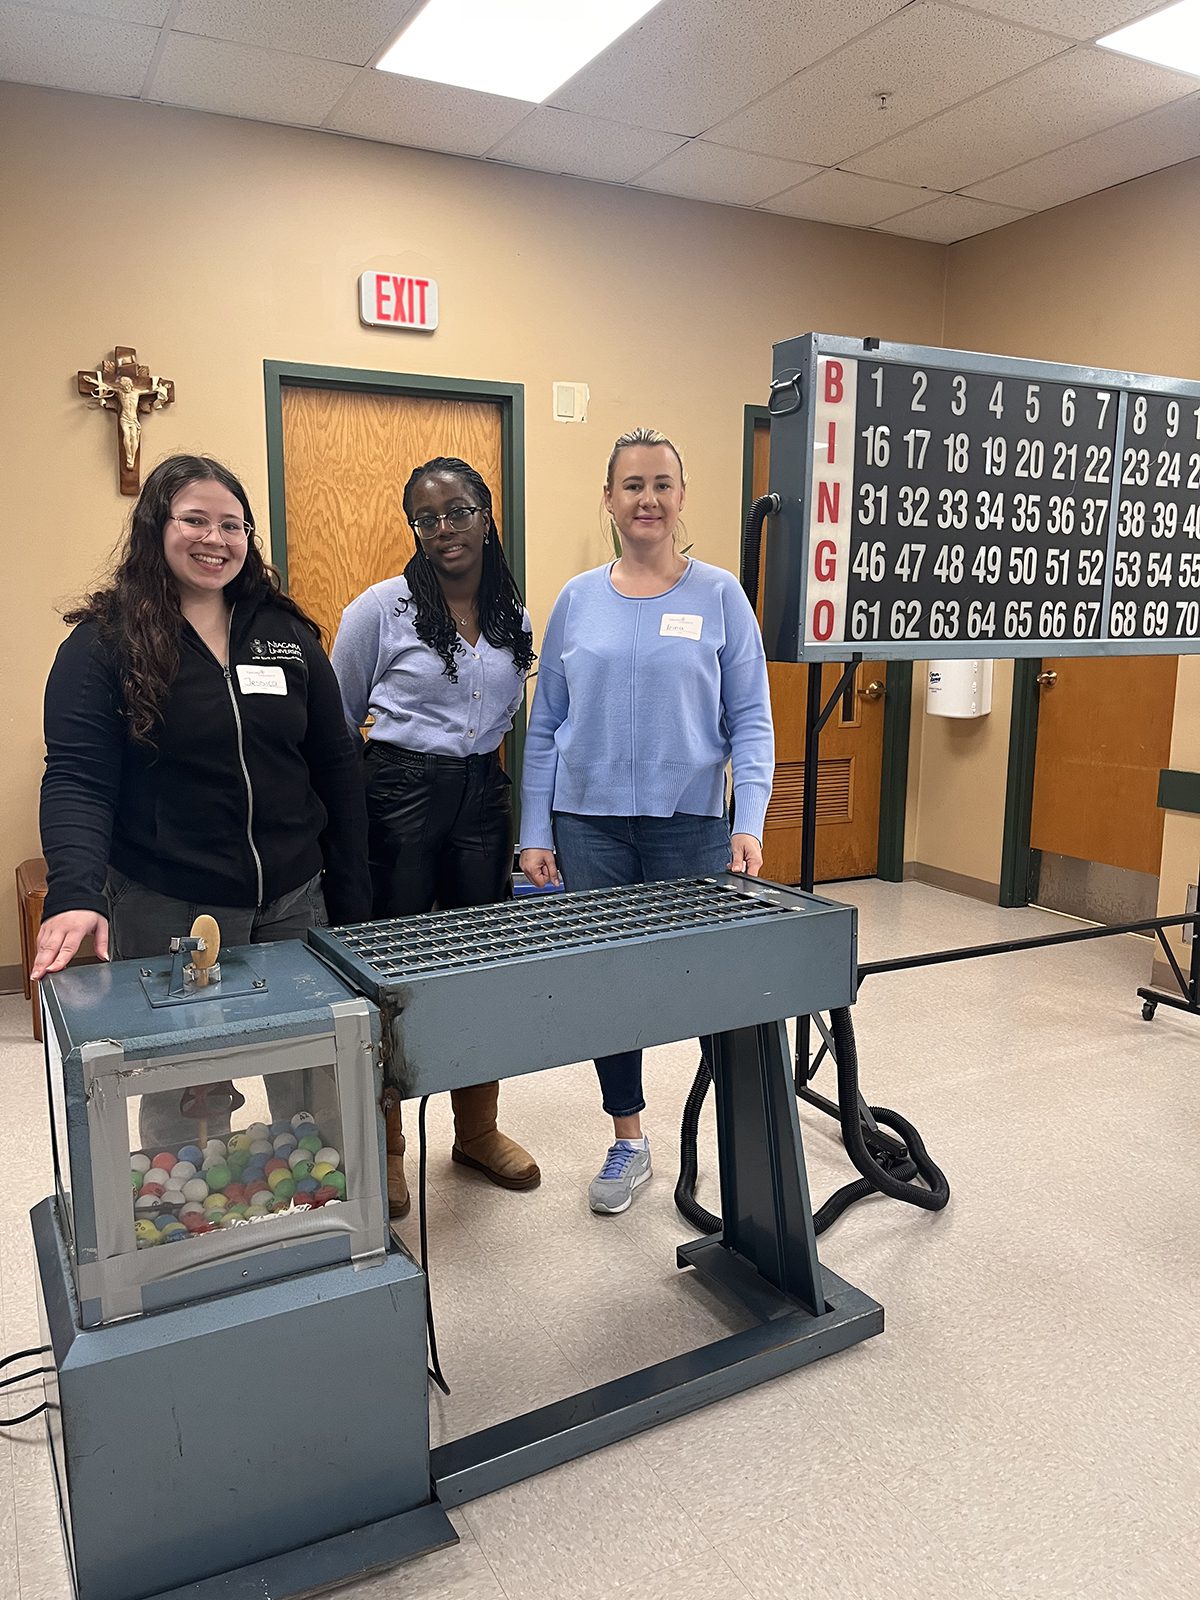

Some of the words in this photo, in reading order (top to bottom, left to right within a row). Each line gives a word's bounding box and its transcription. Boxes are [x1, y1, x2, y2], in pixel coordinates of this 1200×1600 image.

[375, 274, 430, 325] EXIT
[871, 367, 883, 407] 1
[911, 371, 927, 411] 2
[951, 375, 967, 416] 3
[988, 380, 1004, 419] 4
[1025, 384, 1040, 423] 5
[1061, 388, 1077, 427] 6
[1096, 392, 1111, 430] 7
[1132, 396, 1148, 435] 8
[1166, 400, 1180, 438] 9
[861, 425, 891, 467] 16
[903, 428, 931, 470] 17
[943, 432, 970, 474] 18
[981, 436, 1007, 476] 19
[1014, 438, 1045, 479] 20
[1051, 441, 1078, 481] 21
[1083, 444, 1112, 484] 22
[1121, 447, 1150, 487] 23
[1155, 450, 1181, 488] 24
[1186, 452, 1200, 490] 2
[812, 360, 844, 642] BINGO
[858, 483, 888, 525] 31
[897, 485, 930, 527] 32
[937, 488, 969, 530] 33
[974, 490, 1005, 531] 34
[1011, 492, 1041, 533] 35
[1046, 495, 1076, 535] 36
[1080, 497, 1109, 536] 37
[1117, 499, 1146, 538] 38
[1151, 501, 1178, 539] 39
[852, 541, 886, 583] 46
[894, 543, 927, 583] 47
[933, 544, 965, 584] 48
[971, 545, 1002, 585] 49
[1008, 546, 1038, 585] 50
[1045, 548, 1070, 586] 51
[1077, 549, 1104, 586] 52
[1114, 550, 1142, 588] 53
[1146, 552, 1173, 588] 54
[851, 599, 881, 640] 61
[890, 599, 922, 640] 62
[929, 600, 960, 639] 63
[967, 600, 996, 639] 64
[1004, 600, 1033, 638] 65
[1038, 600, 1067, 638] 66
[1073, 601, 1101, 638] 67
[1110, 600, 1137, 637] 68
[1142, 600, 1169, 637] 69
[1175, 600, 1200, 636] 70
